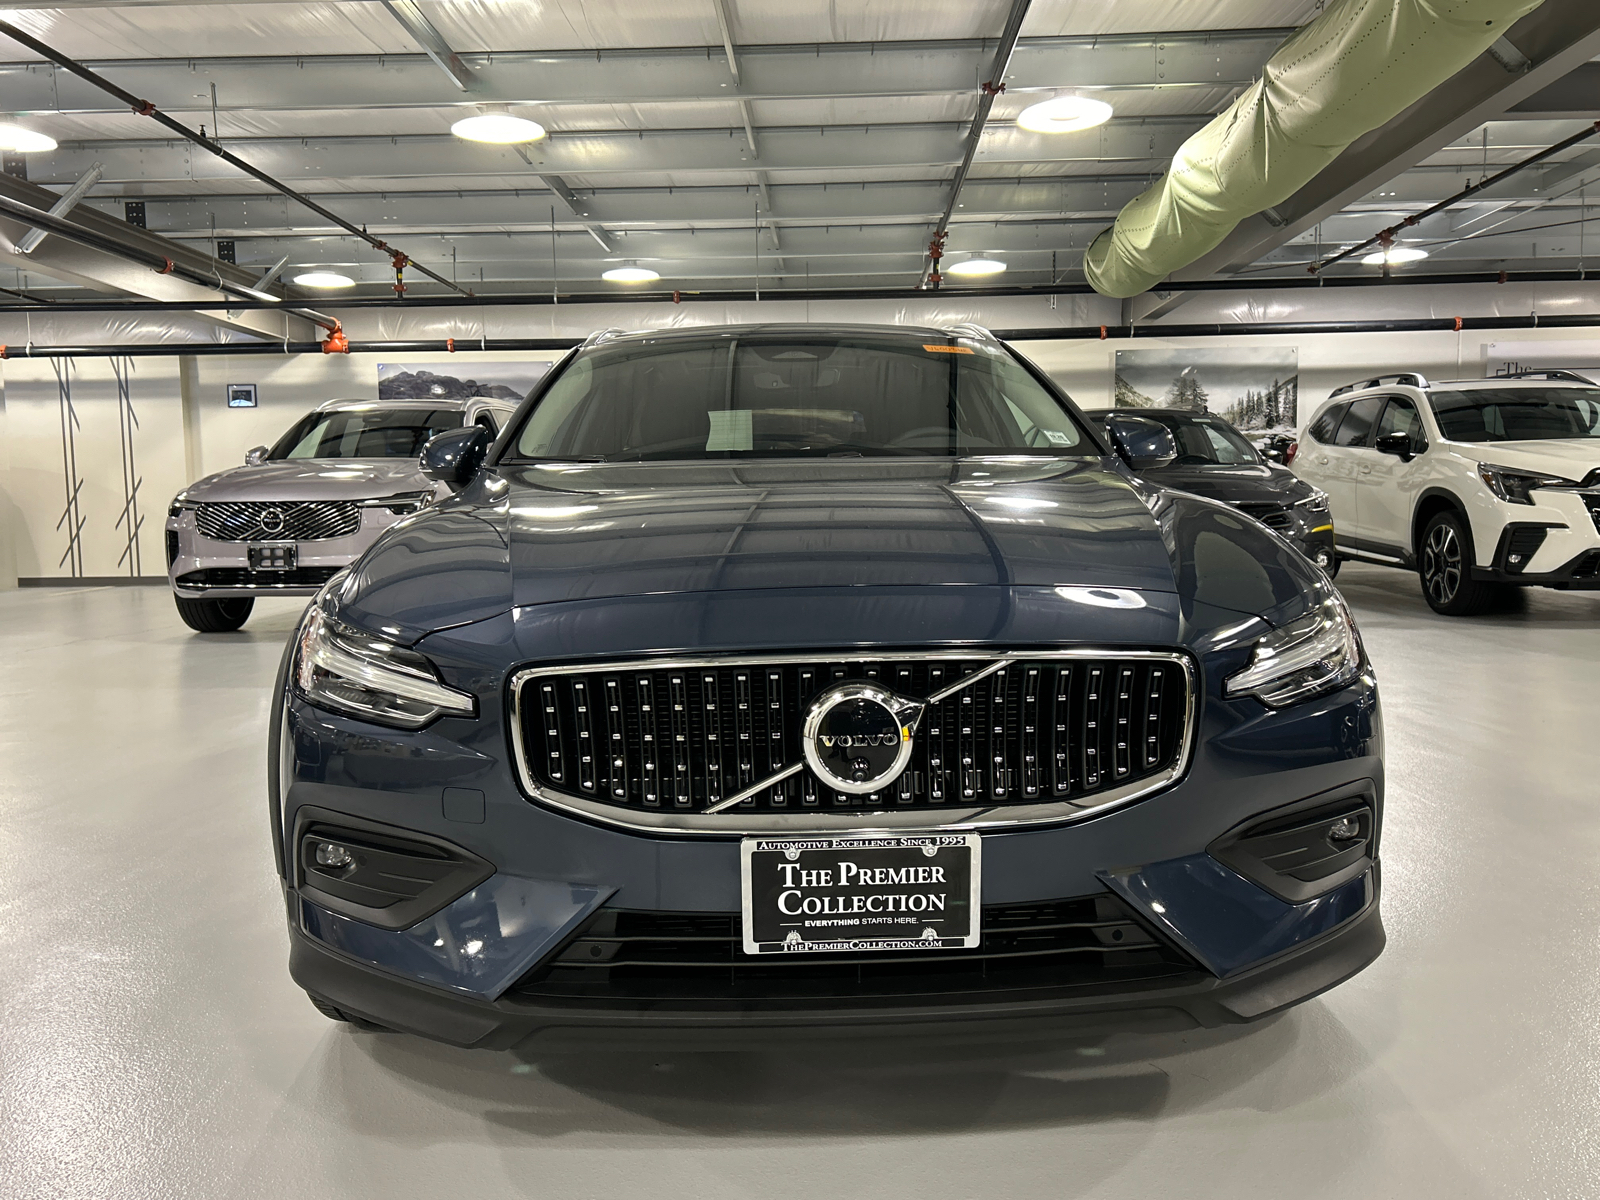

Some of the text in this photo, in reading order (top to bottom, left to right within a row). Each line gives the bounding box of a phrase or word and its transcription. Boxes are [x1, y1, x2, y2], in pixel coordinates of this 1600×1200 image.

[1503, 361, 1532, 375] The
[819, 734, 898, 747] VOLVO
[759, 837, 964, 850] AUTOMOTIVE EXCELLENCE SINCE 1995
[777, 862, 946, 888] THE PREMIER
[777, 890, 946, 915] COLLECTION
[804, 918, 860, 927] EVERYTHING
[861, 917, 893, 925] STARTS
[781, 940, 943, 952] THEPREMIERCOLLECTION.COM
